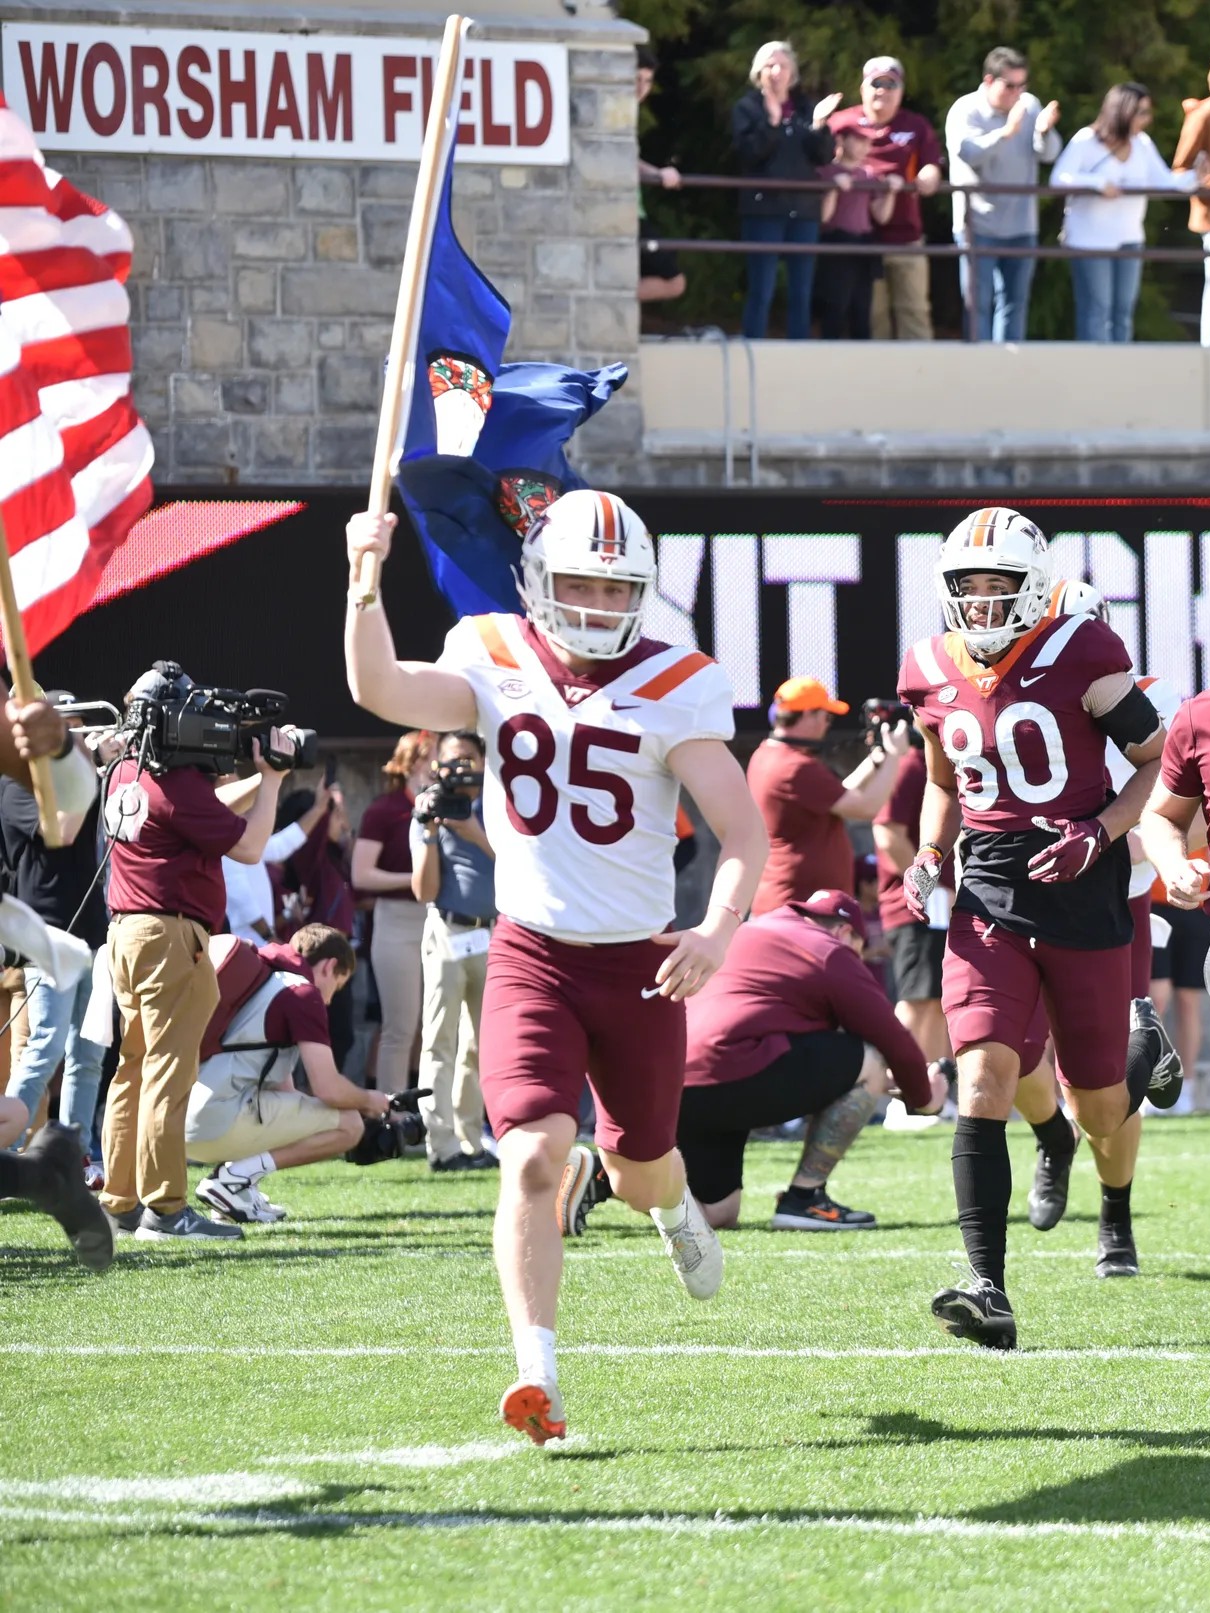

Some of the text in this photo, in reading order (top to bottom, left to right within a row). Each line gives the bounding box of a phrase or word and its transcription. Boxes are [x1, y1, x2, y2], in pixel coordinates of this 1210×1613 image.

[18, 40, 353, 141] WORSHAM
[600, 555, 617, 565] VT
[562, 685, 592, 701] VT
[975, 675, 997, 690] VT
[497, 712, 641, 845] 85
[943, 700, 1068, 811] 80
